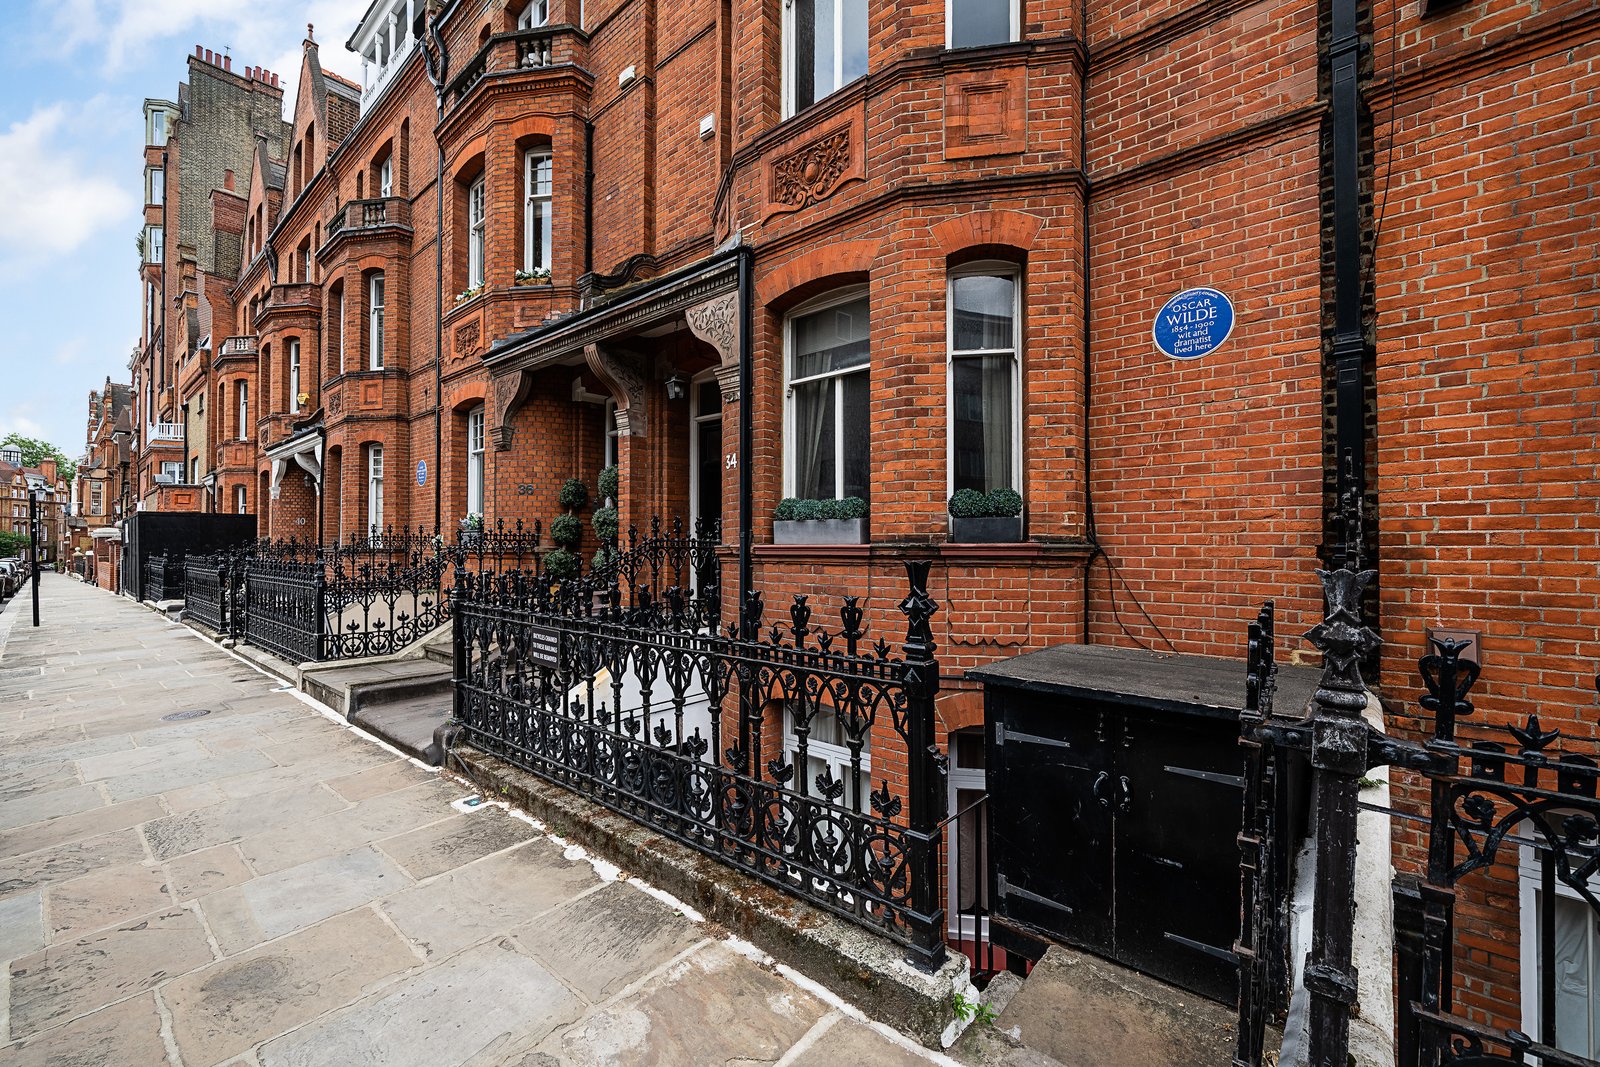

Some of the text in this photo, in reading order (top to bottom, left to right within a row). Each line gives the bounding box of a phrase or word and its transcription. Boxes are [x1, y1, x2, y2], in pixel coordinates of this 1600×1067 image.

[1173, 298, 1211, 313] OSCAR
[1166, 306, 1217, 326] WILDE
[1178, 327, 1208, 339] wit and
[1174, 335, 1211, 348] dramatist
[1195, 343, 1212, 351] here
[725, 452, 738, 470] 34
[518, 483, 534, 496] 36
